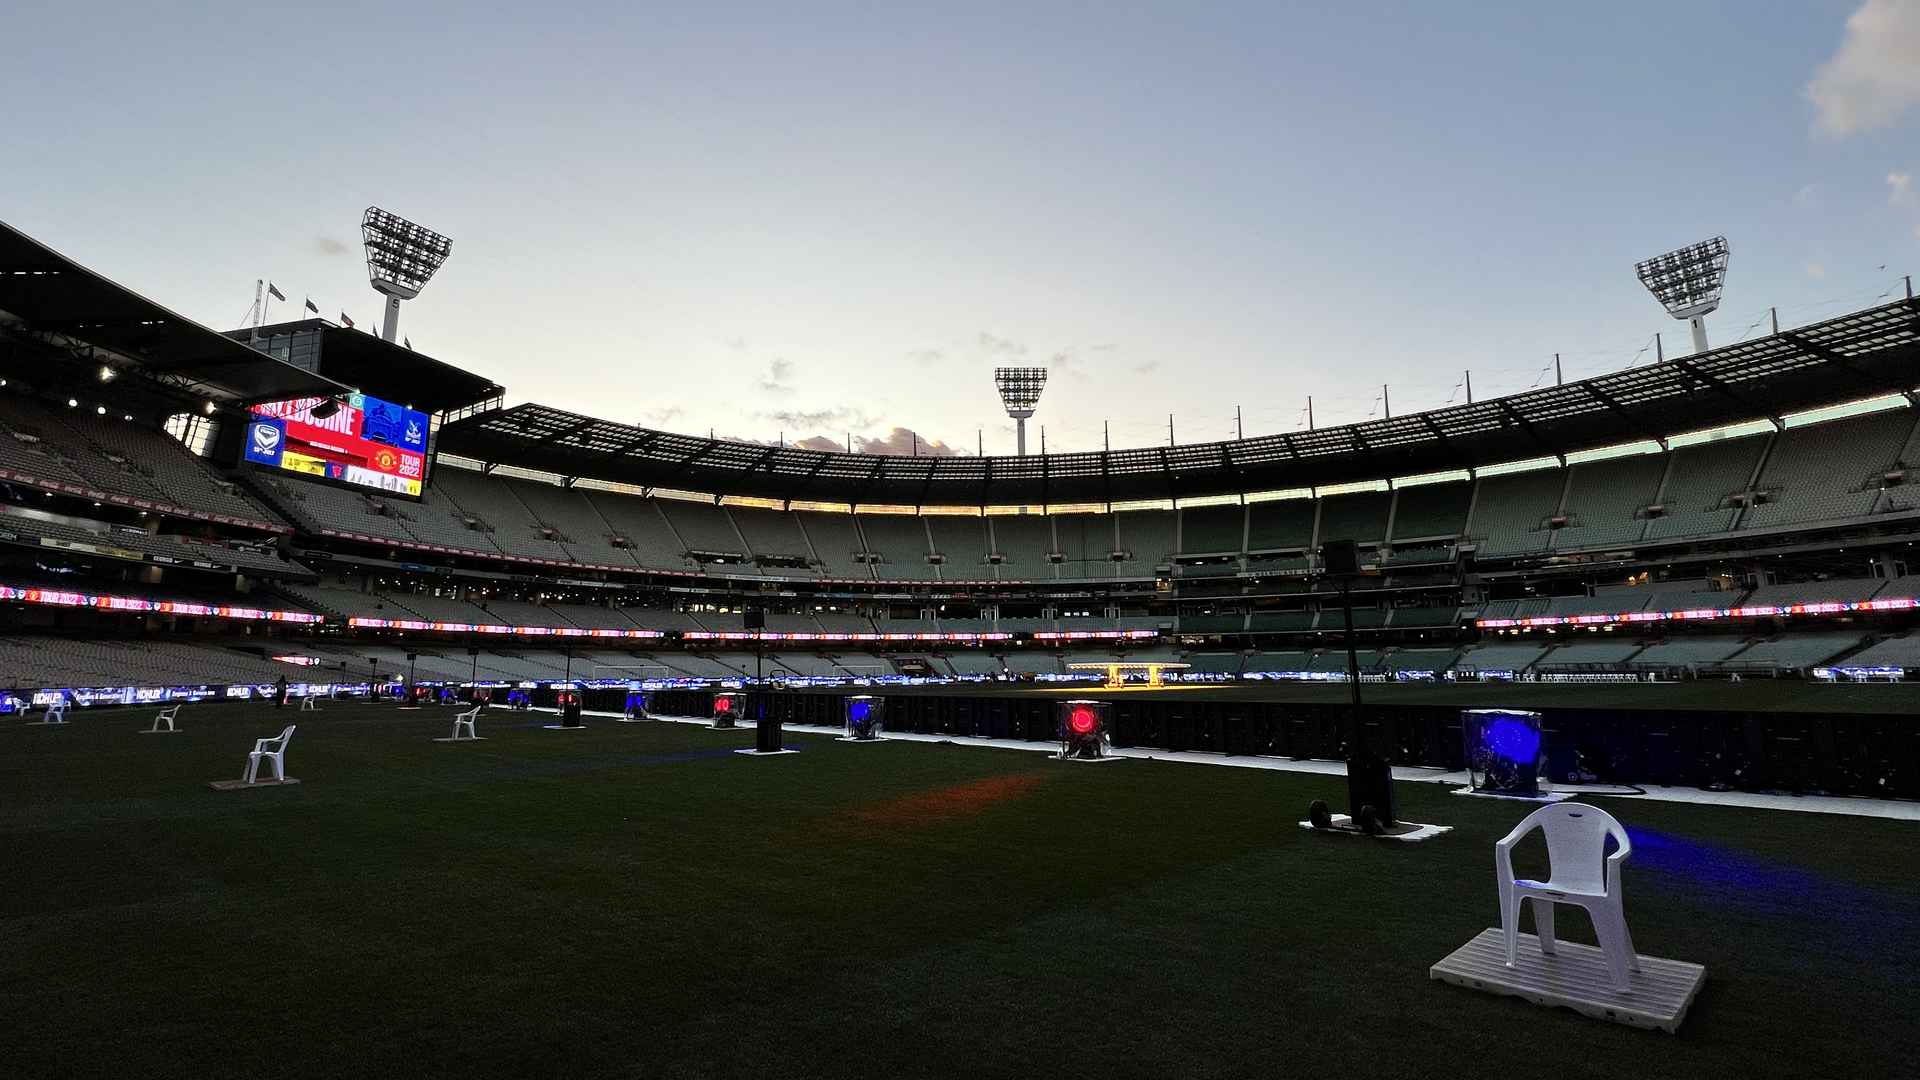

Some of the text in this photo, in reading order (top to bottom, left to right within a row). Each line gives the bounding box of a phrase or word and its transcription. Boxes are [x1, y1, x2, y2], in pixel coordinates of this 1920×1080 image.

[262, 397, 355, 435] MELBONE
[400, 454, 421, 468] TOUR
[399, 464, 419, 477] 2022
[136, 688, 161, 699] KOHLER
[226, 687, 249, 697] KOHLER
